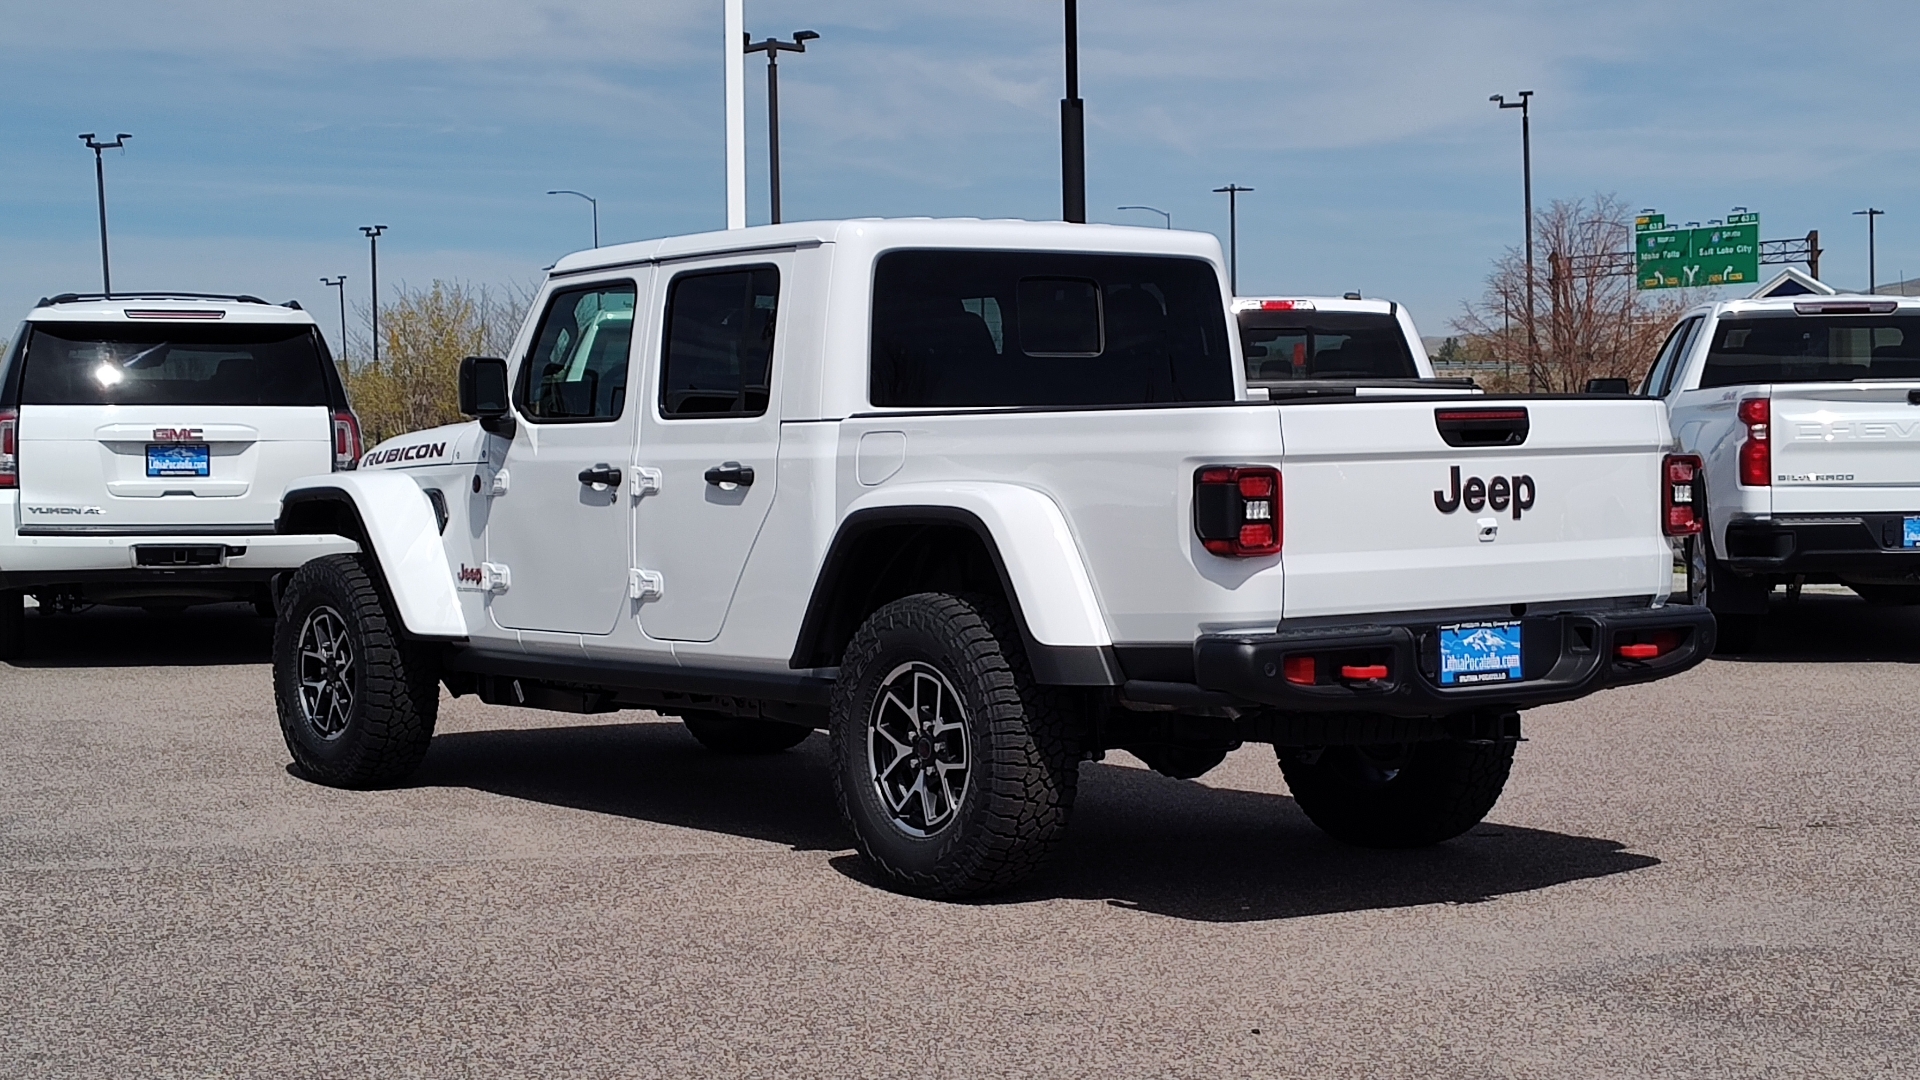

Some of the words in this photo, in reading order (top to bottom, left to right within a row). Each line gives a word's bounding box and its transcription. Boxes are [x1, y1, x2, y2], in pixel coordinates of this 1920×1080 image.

[1662, 251, 1681, 259] Falls
[1716, 247, 1734, 255] Lake
[1736, 244, 1753, 254] City
[153, 429, 203, 441] GMC
[362, 442, 447, 467] RUBICON
[149, 460, 208, 470] LithiaPocatello.com
[1777, 473, 1855, 482] SILVRADO
[1433, 465, 1536, 521] Jeep
[28, 507, 81, 515] YUKON
[457, 563, 482, 586] Jeep
[1441, 652, 1520, 672] LithiaPocatello.com
